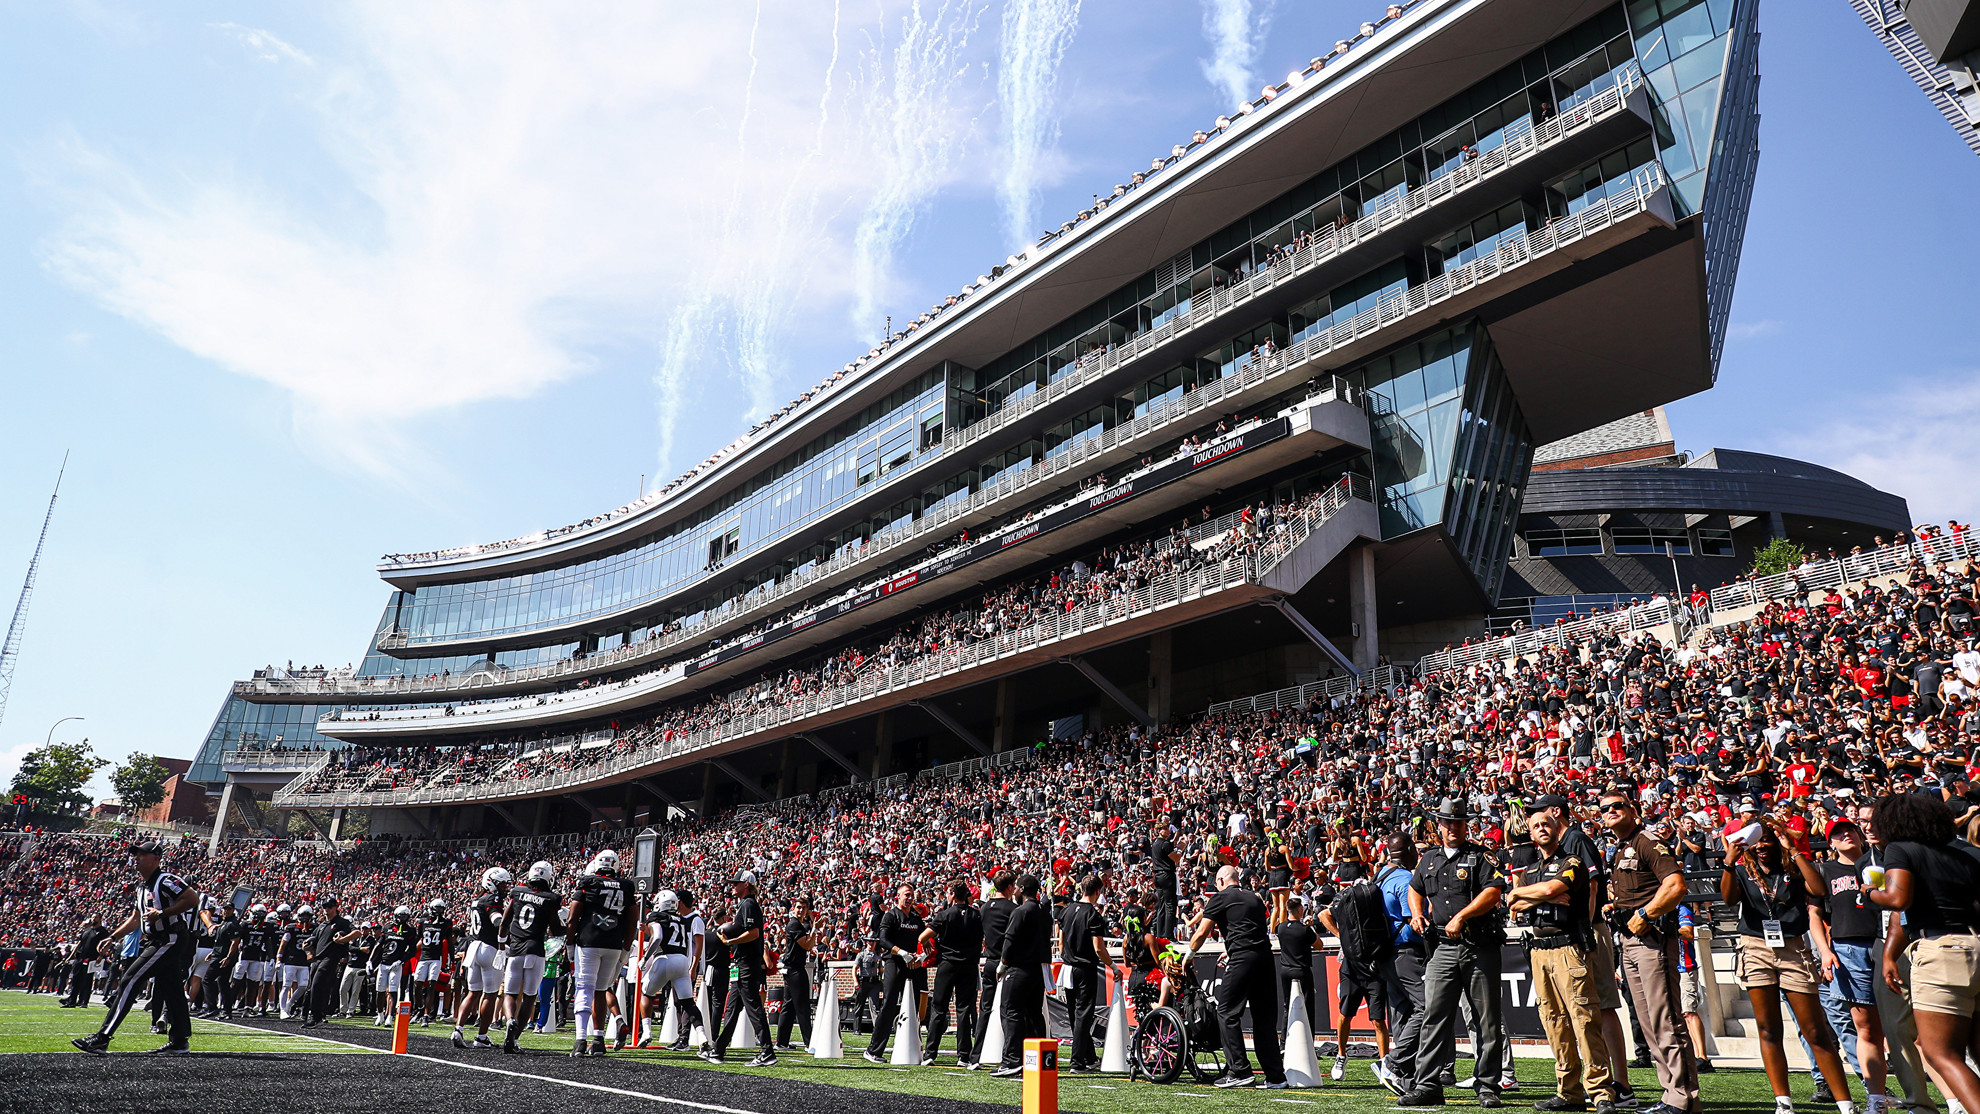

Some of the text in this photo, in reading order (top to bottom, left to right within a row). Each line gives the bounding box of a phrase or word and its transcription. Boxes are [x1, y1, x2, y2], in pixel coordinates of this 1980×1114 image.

[1192, 436, 1244, 466] TOUCHDOWN
[1089, 482, 1134, 508] TOUCHDOWN
[1001, 523, 1040, 546] TOUCHDOWN
[888, 575, 917, 592] 0 HOUSTON
[875, 588, 880, 598] 6
[791, 614, 818, 630] TOUCHDOWN
[742, 635, 764, 650] TOUCHDOWN
[698, 655, 718, 669] TOUCHDOWN
[12, 794, 28, 804] 25
[599, 889, 625, 915] 74
[518, 903, 535, 930] 0
[248, 935, 263, 947] 14
[422, 931, 441, 946] 84
[667, 922, 687, 948] 21
